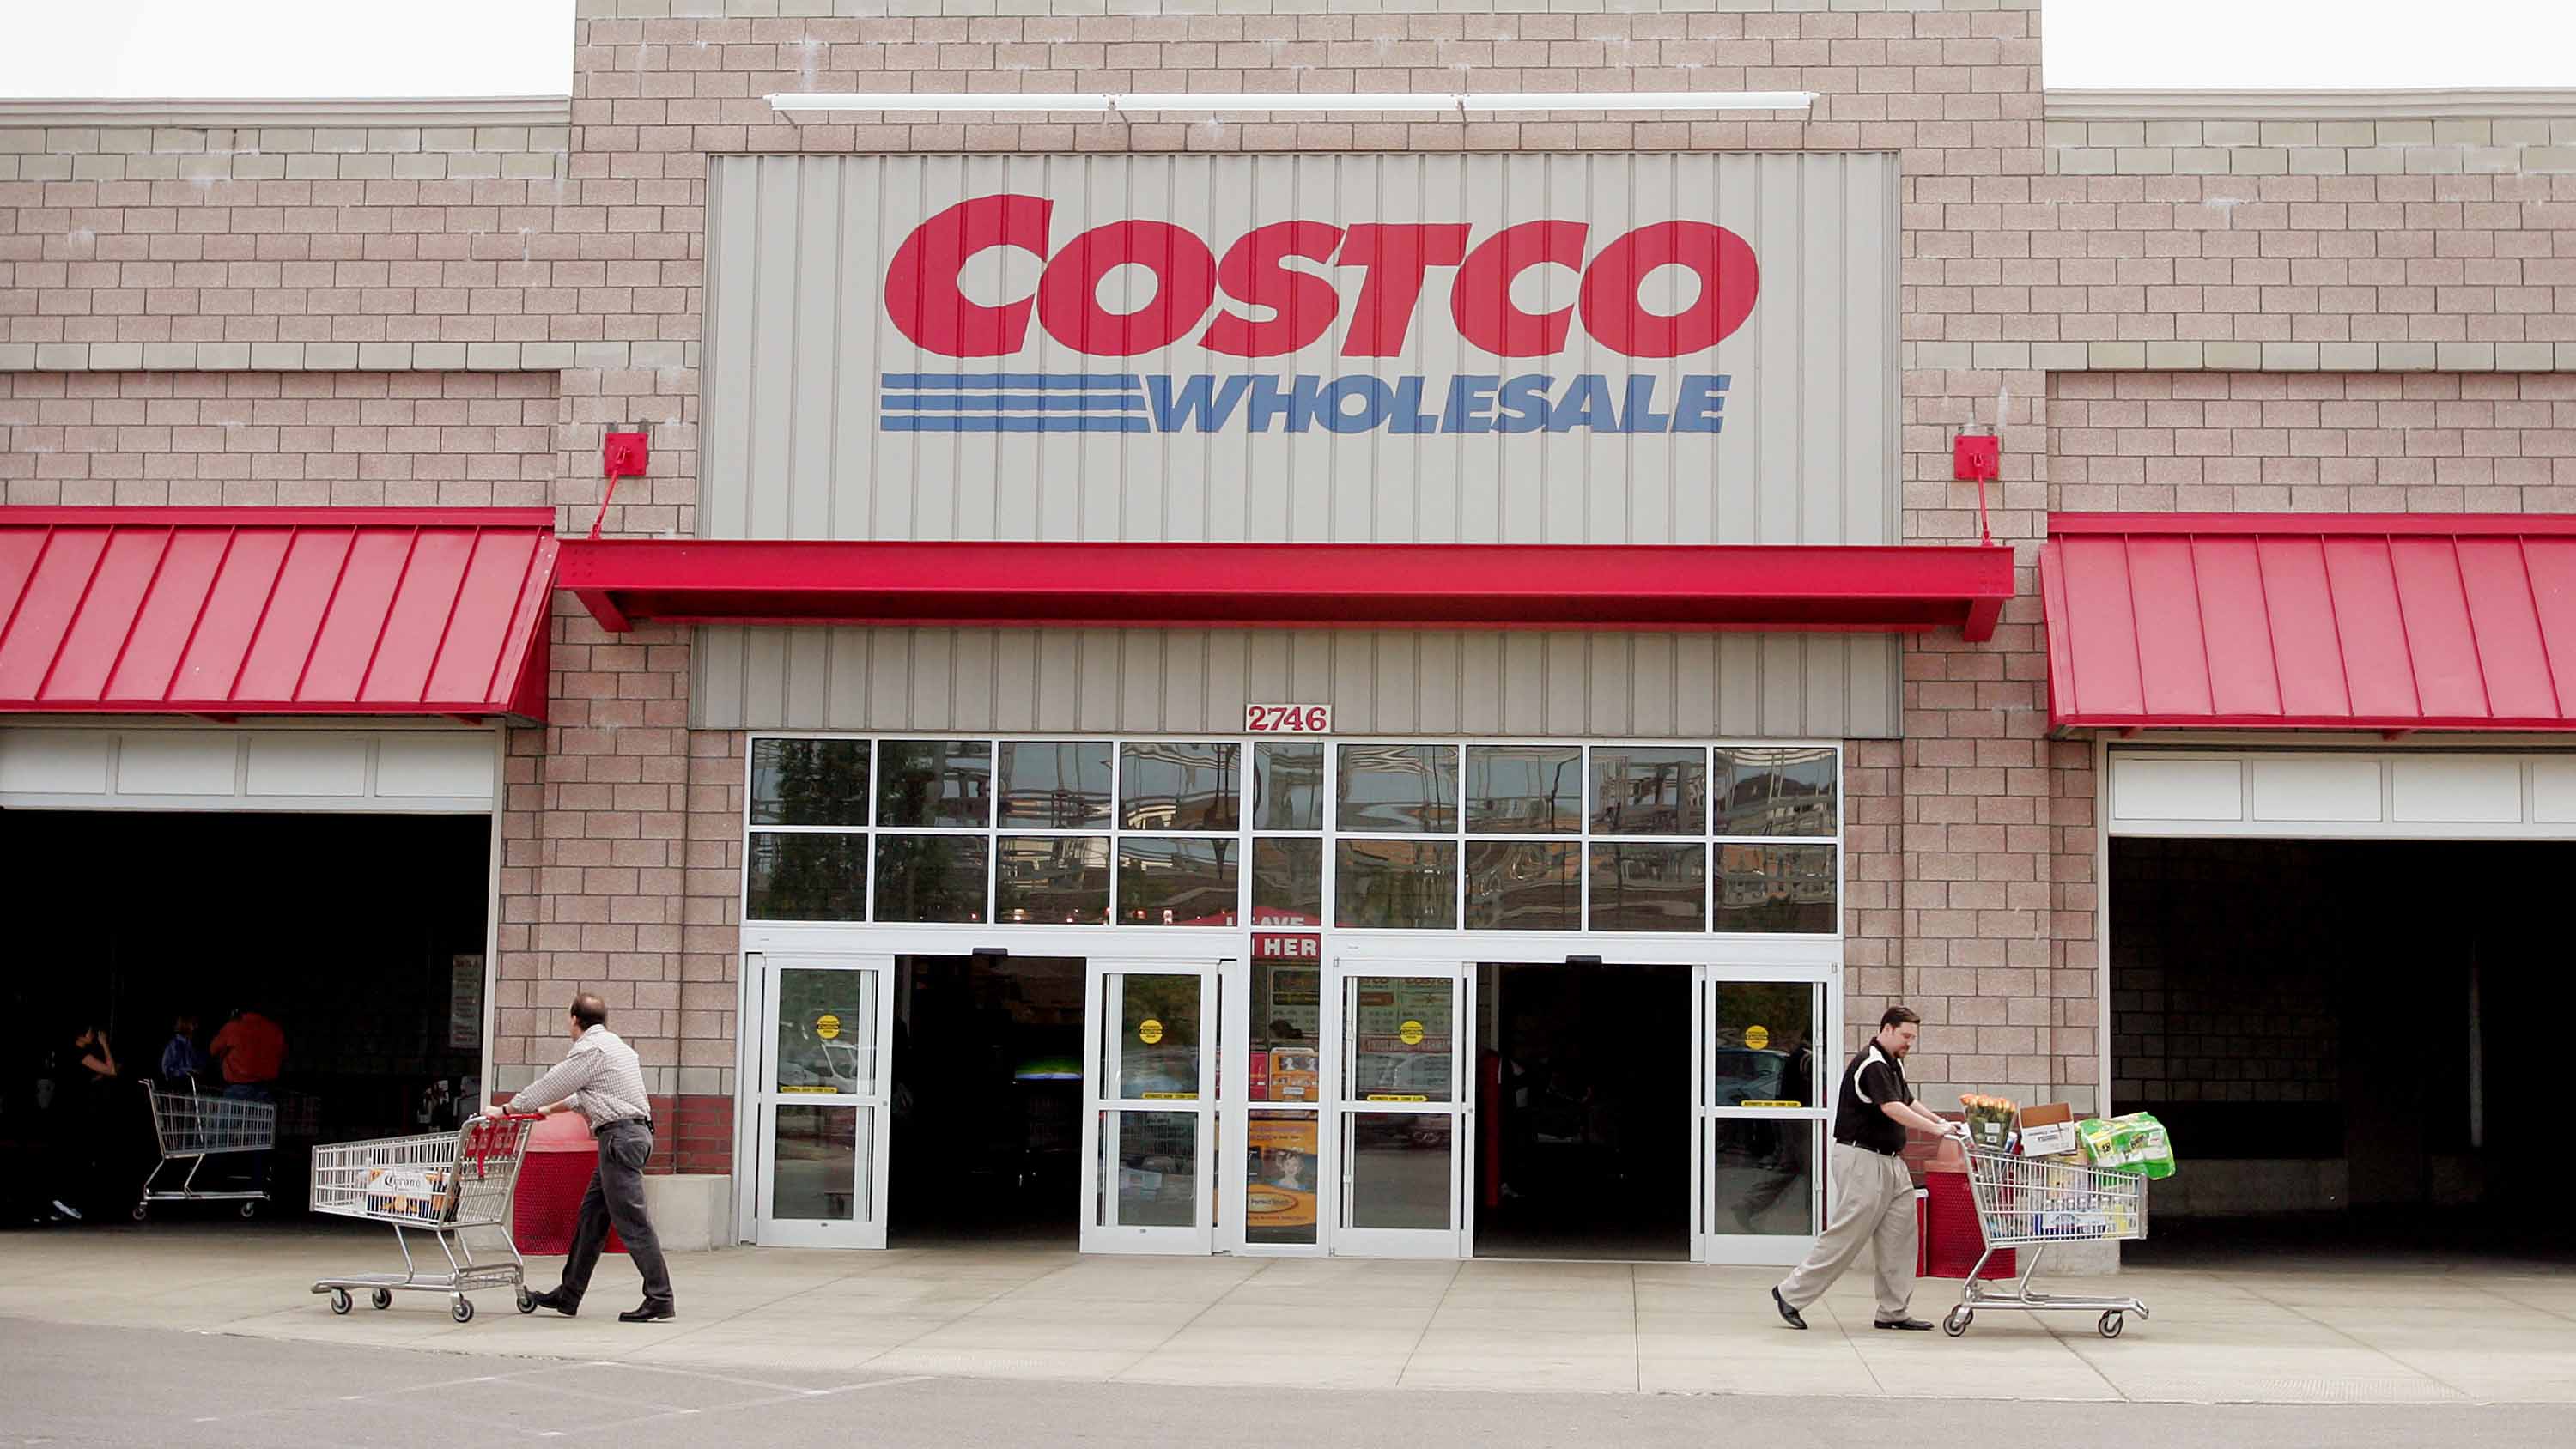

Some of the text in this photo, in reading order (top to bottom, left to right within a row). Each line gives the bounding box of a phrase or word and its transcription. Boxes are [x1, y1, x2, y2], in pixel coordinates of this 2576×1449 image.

[884, 194, 1759, 357] COSTCO
[1145, 374, 1731, 433] WHOLESALE
[1249, 706, 1327, 731] 2746
